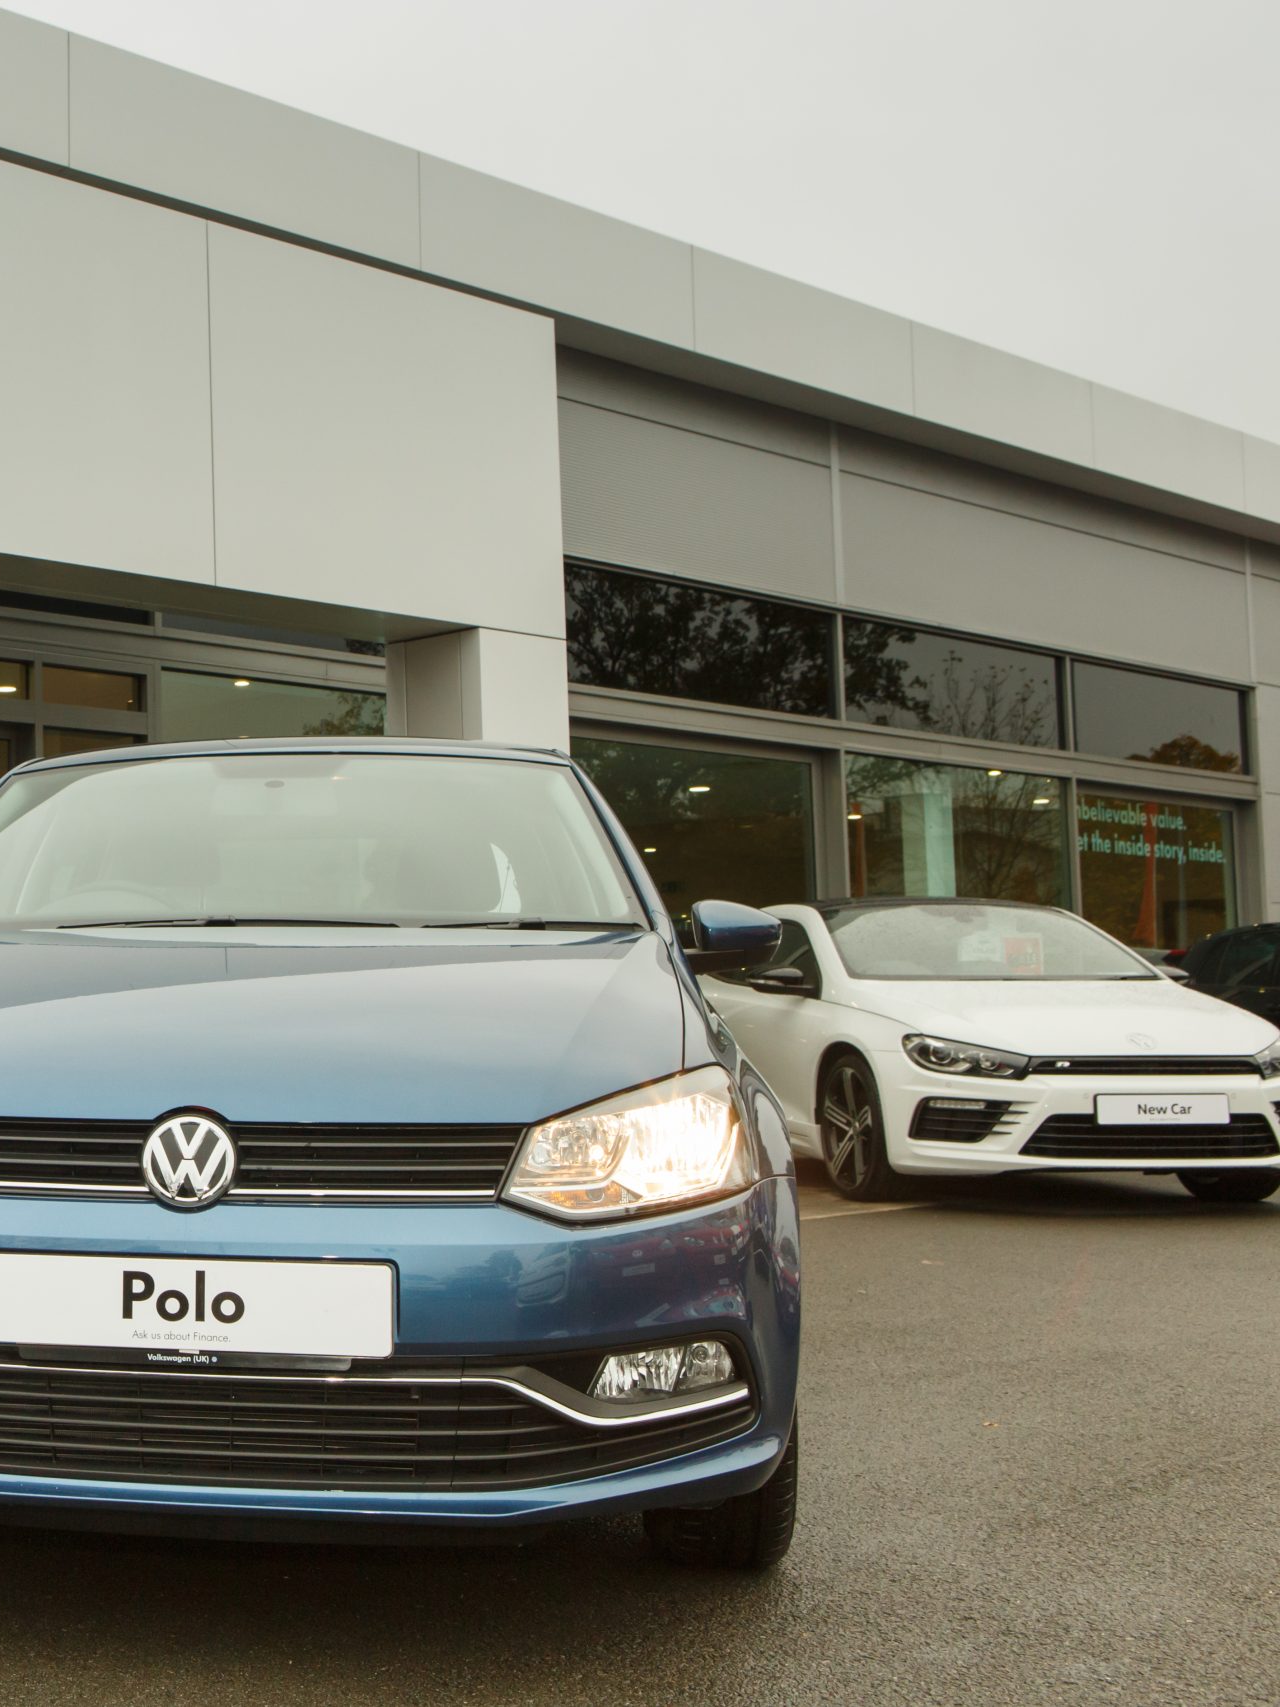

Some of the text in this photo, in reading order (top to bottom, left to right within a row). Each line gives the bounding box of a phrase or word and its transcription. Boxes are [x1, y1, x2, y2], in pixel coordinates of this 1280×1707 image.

[1077, 798, 1187, 831] nbelievable value.
[1077, 830, 1227, 865] et the inside story, inside.
[1137, 1103, 1192, 1115] New Car
[145, 1117, 233, 1204] VW
[122, 1270, 245, 1324] Polo
[131, 1330, 232, 1343] Ask us about Finance.
[147, 1353, 210, 1365] Volkswagen (UK)
